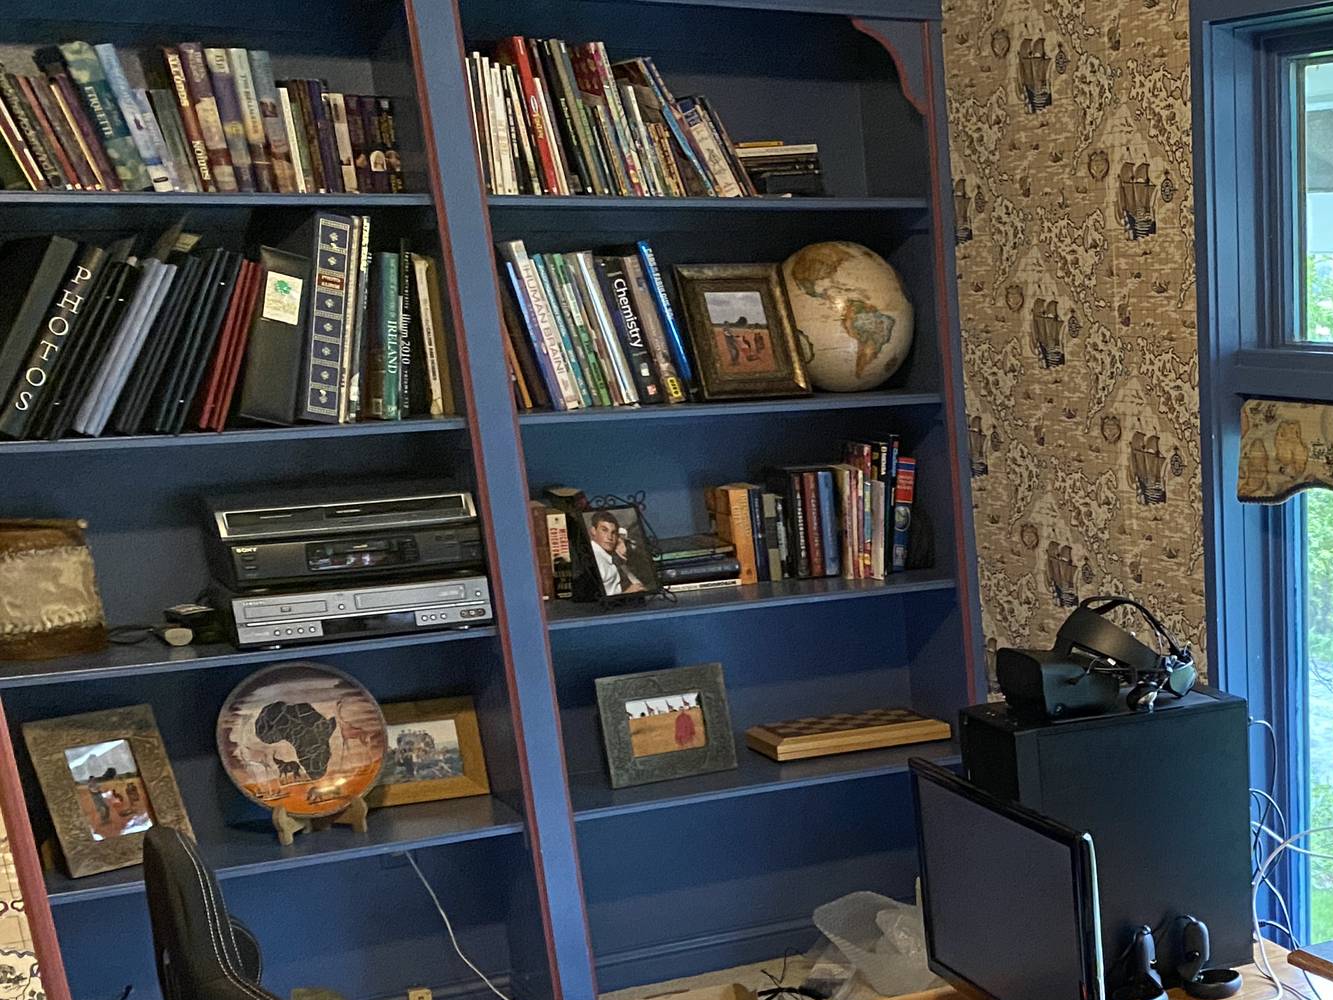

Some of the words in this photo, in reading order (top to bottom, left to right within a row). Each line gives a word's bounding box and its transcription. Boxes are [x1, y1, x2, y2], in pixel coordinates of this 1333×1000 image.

[84, 85, 114, 138] ETIQUETTE
[15, 264, 92, 411] PHOTOS
[401, 314, 410, 338] ilium
[613, 277, 645, 349] Chemistry
[386, 320, 398, 373] IRELAND
[402, 341, 410, 365] 2010
